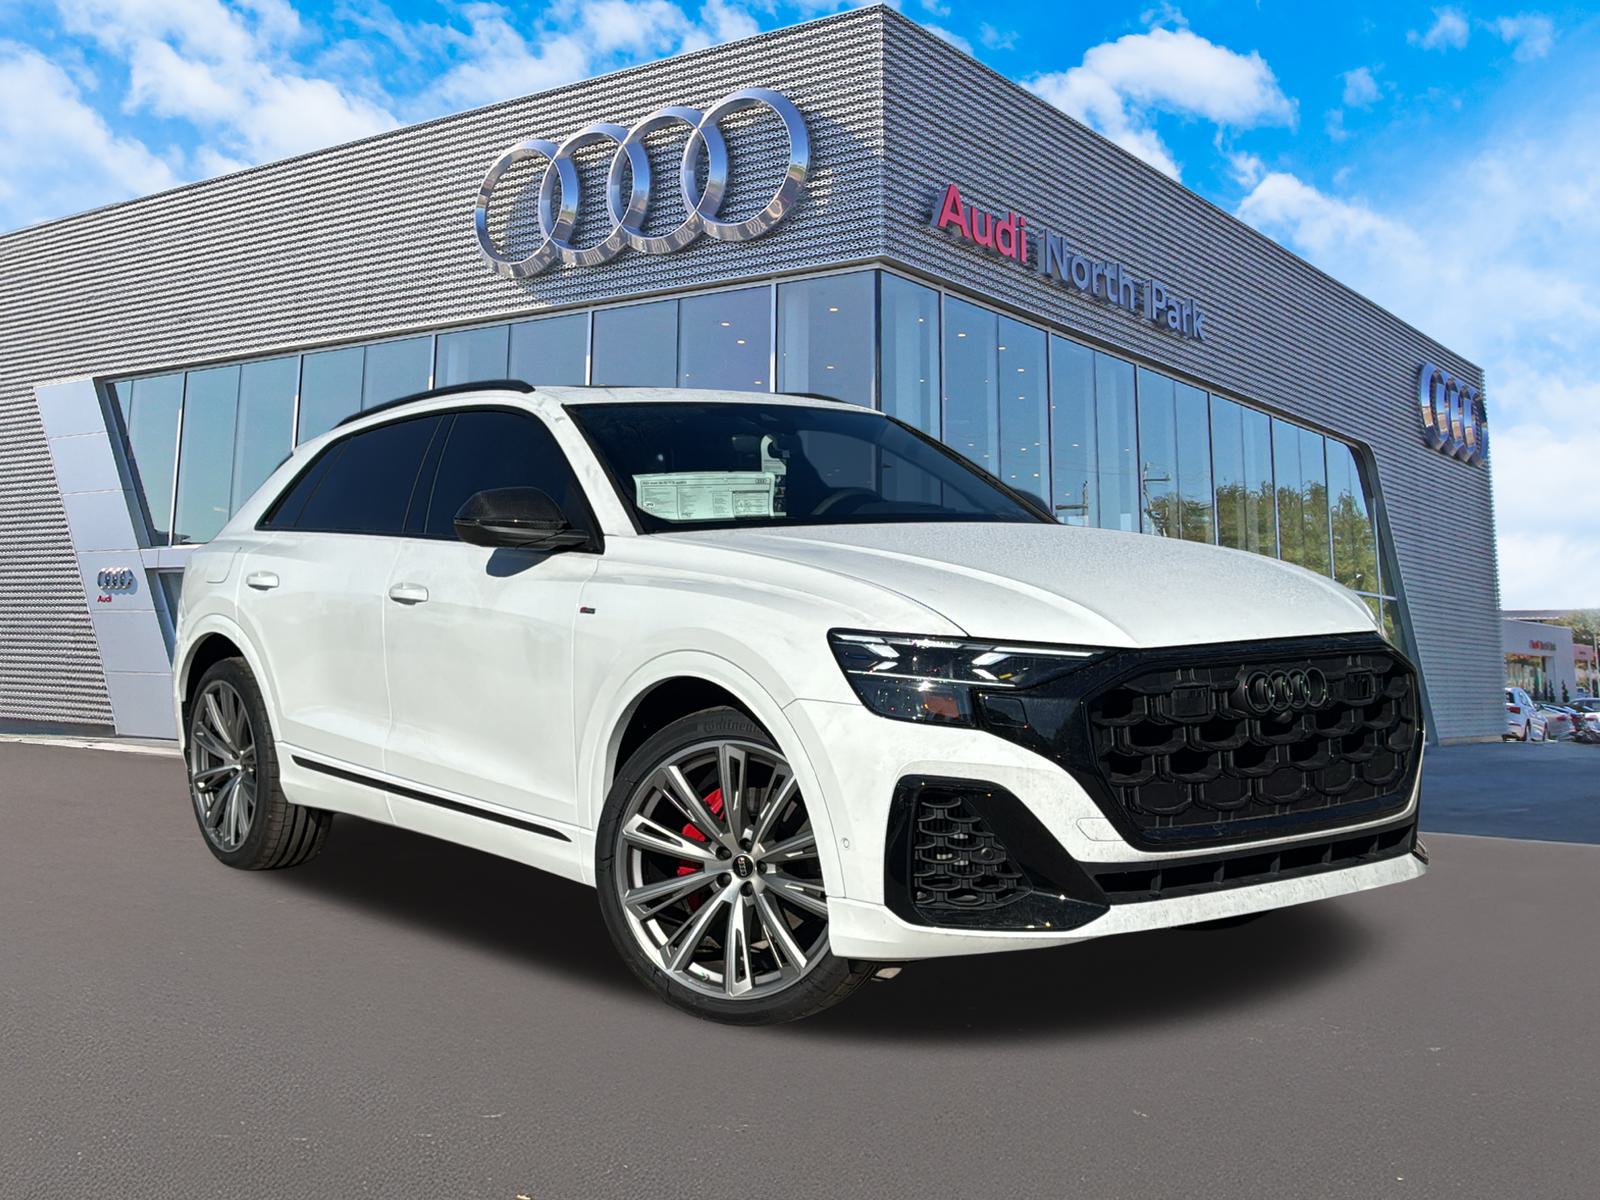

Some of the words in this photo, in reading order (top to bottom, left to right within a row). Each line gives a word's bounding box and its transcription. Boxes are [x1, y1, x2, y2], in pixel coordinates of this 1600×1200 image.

[935, 183, 1028, 263] Audi
[1042, 229, 1136, 310] North
[1147, 279, 1206, 341] Park
[703, 715, 764, 735] Continent
